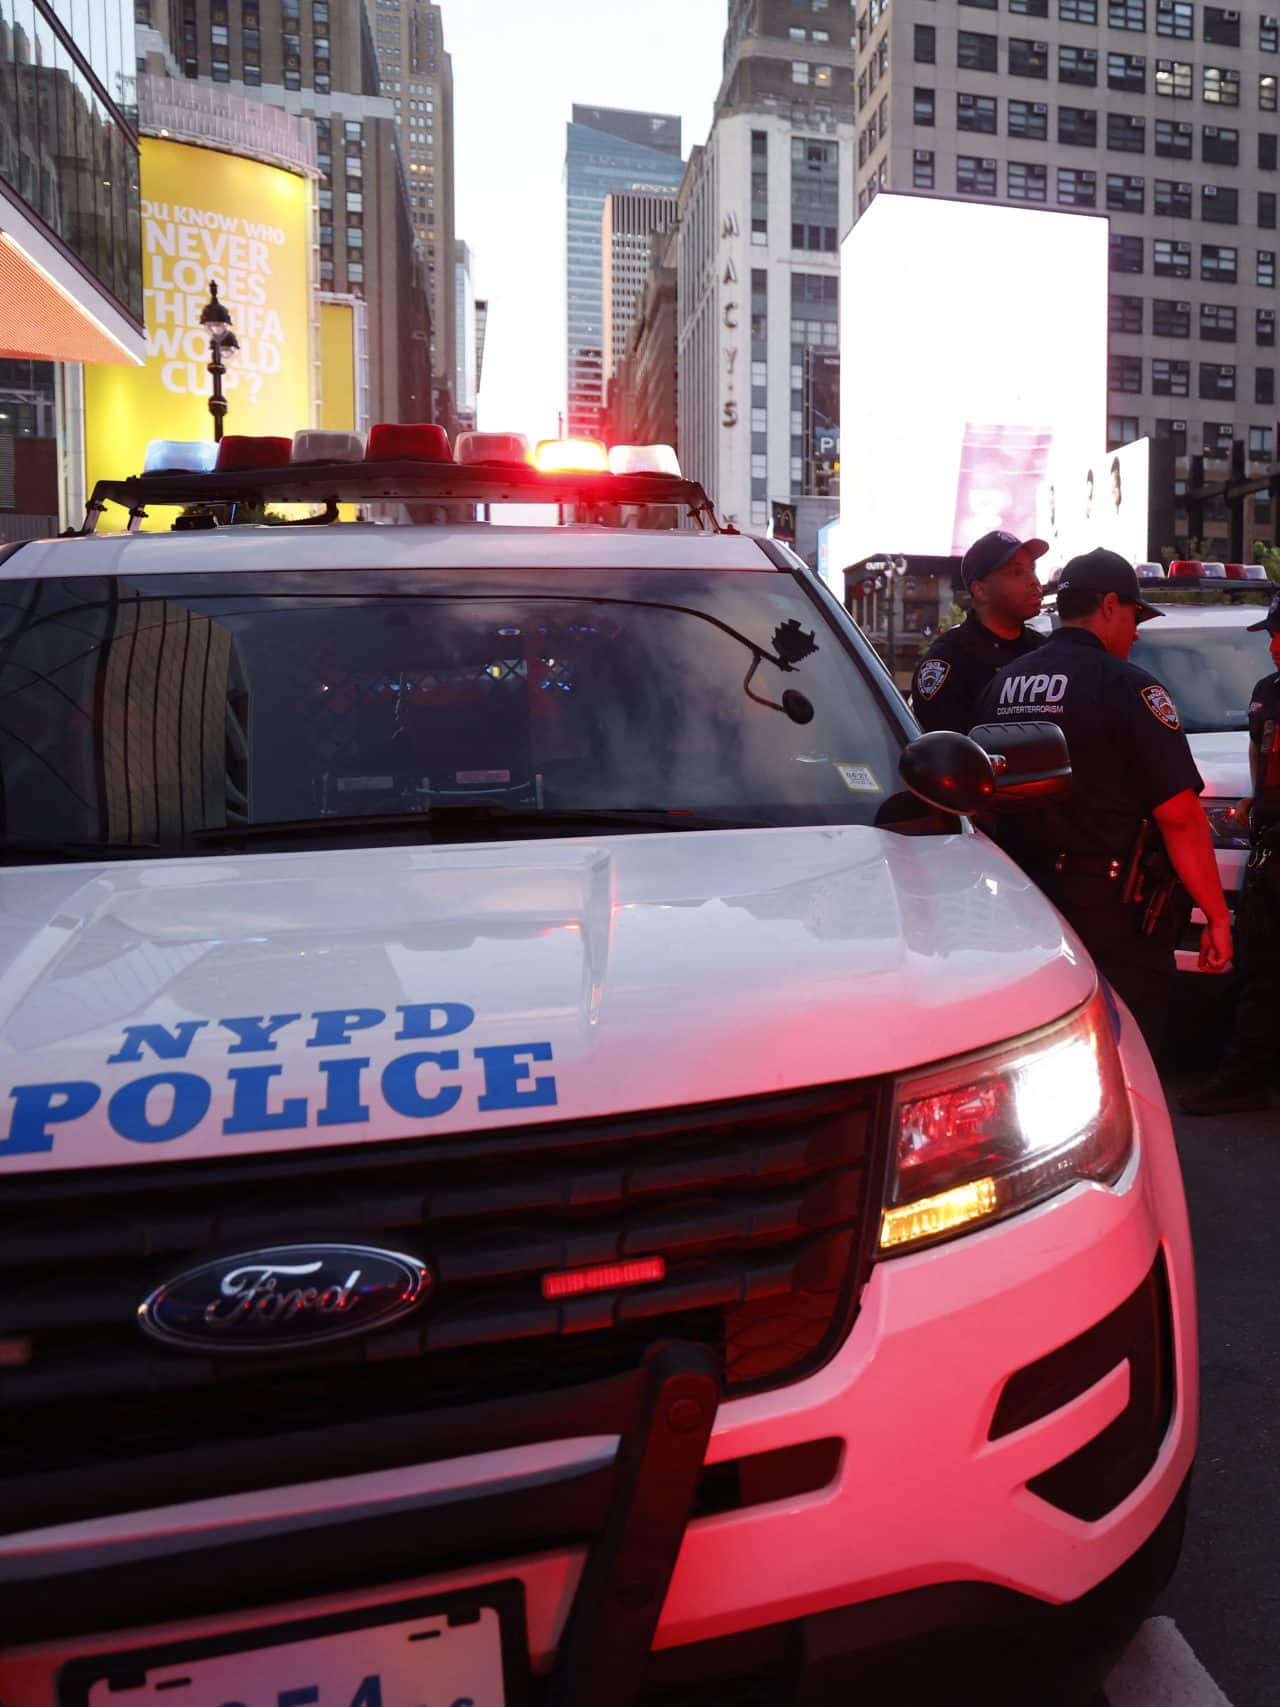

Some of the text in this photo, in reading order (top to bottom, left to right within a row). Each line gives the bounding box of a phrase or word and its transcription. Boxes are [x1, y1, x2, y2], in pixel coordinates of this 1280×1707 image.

[140, 200, 286, 245] OU KNOW WHO
[146, 219, 272, 275] NEVER
[152, 255, 267, 306] LOSES
[229, 301, 287, 344] IFA
[996, 704, 1064, 716] COUNTERTERRORISM
[999, 674, 1069, 704] NYPD
[107, 1001, 474, 1064] NYPD
[0, 1041, 559, 1157] POLICE
[204, 1260, 361, 1329] Ford
